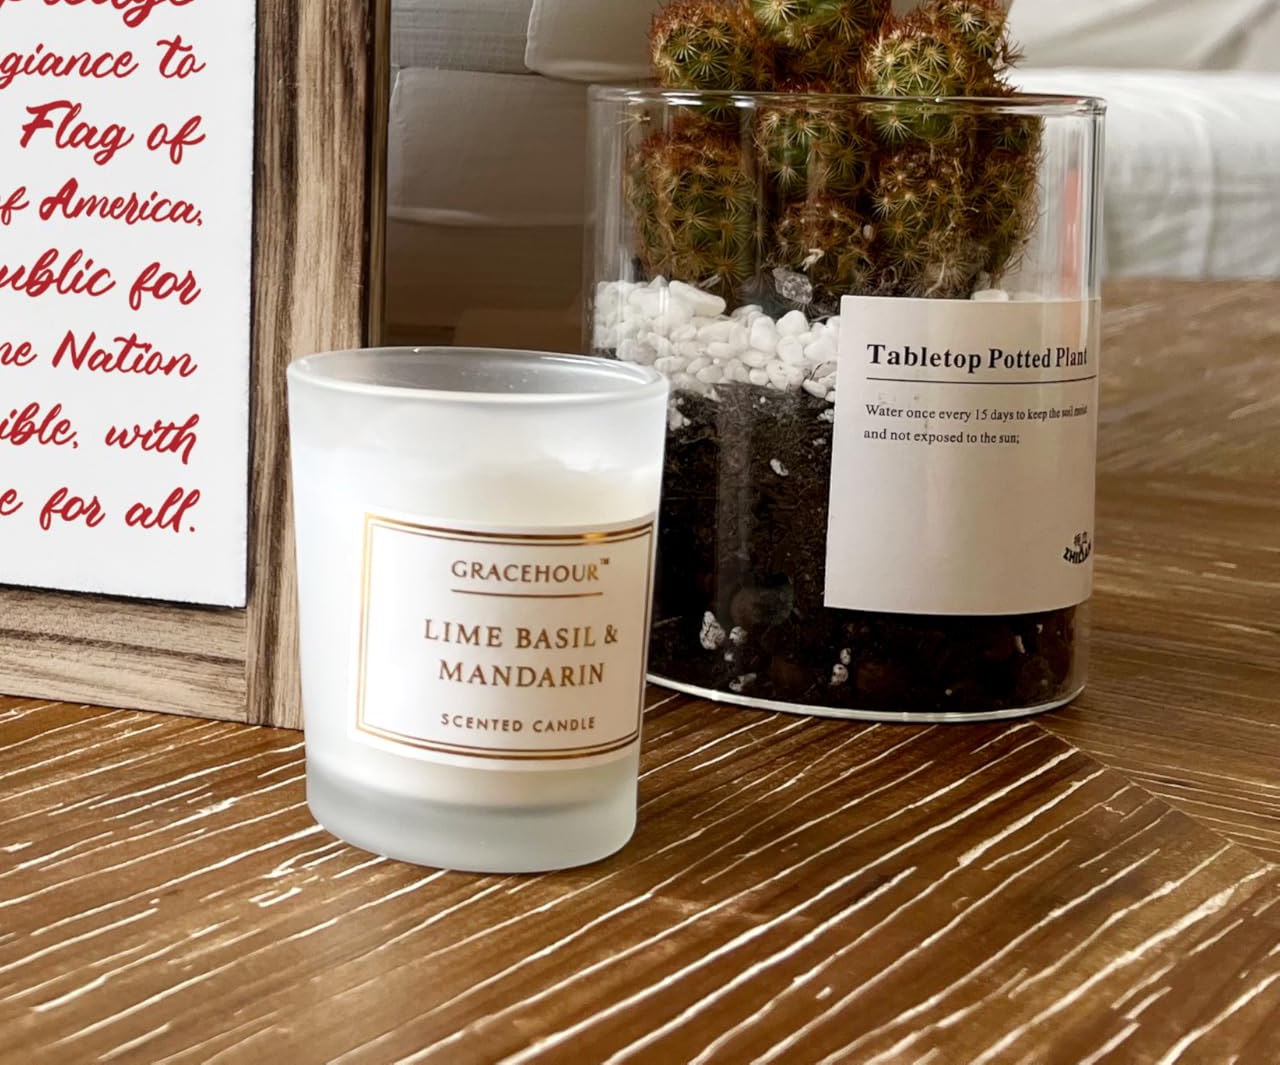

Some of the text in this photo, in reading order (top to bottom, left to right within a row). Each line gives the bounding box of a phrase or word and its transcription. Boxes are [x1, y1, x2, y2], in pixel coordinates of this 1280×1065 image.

[156, 35, 207, 79] to
[19, 99, 135, 165] Flag
[147, 115, 207, 165] of
[39, 177, 203, 227] America,
[128, 262, 202, 311] for
[52, 330, 198, 378] Nation
[867, 343, 1088, 374] Tabletop Potted Plant
[865, 404, 904, 418] Water
[906, 408, 936, 419] once
[938, 409, 972, 423] every
[975, 408, 988, 420] 15
[990, 408, 1014, 422] days
[1016, 410, 1026, 420] to
[1027, 408, 1048, 422] keep
[1048, 408, 1061, 419] the
[105, 413, 200, 466] with
[864, 428, 887, 440] and
[890, 429, 911, 441] not
[913, 431, 964, 445] exposed
[966, 432, 978, 444] to
[980, 431, 997, 444] the
[38, 487, 106, 532] for
[124, 486, 202, 533] all.
[424, 618, 619, 650] LIME BASIL &
[438, 658, 606, 688] MANDARIN
[440, 712, 596, 733] SCENTED CANDLE
